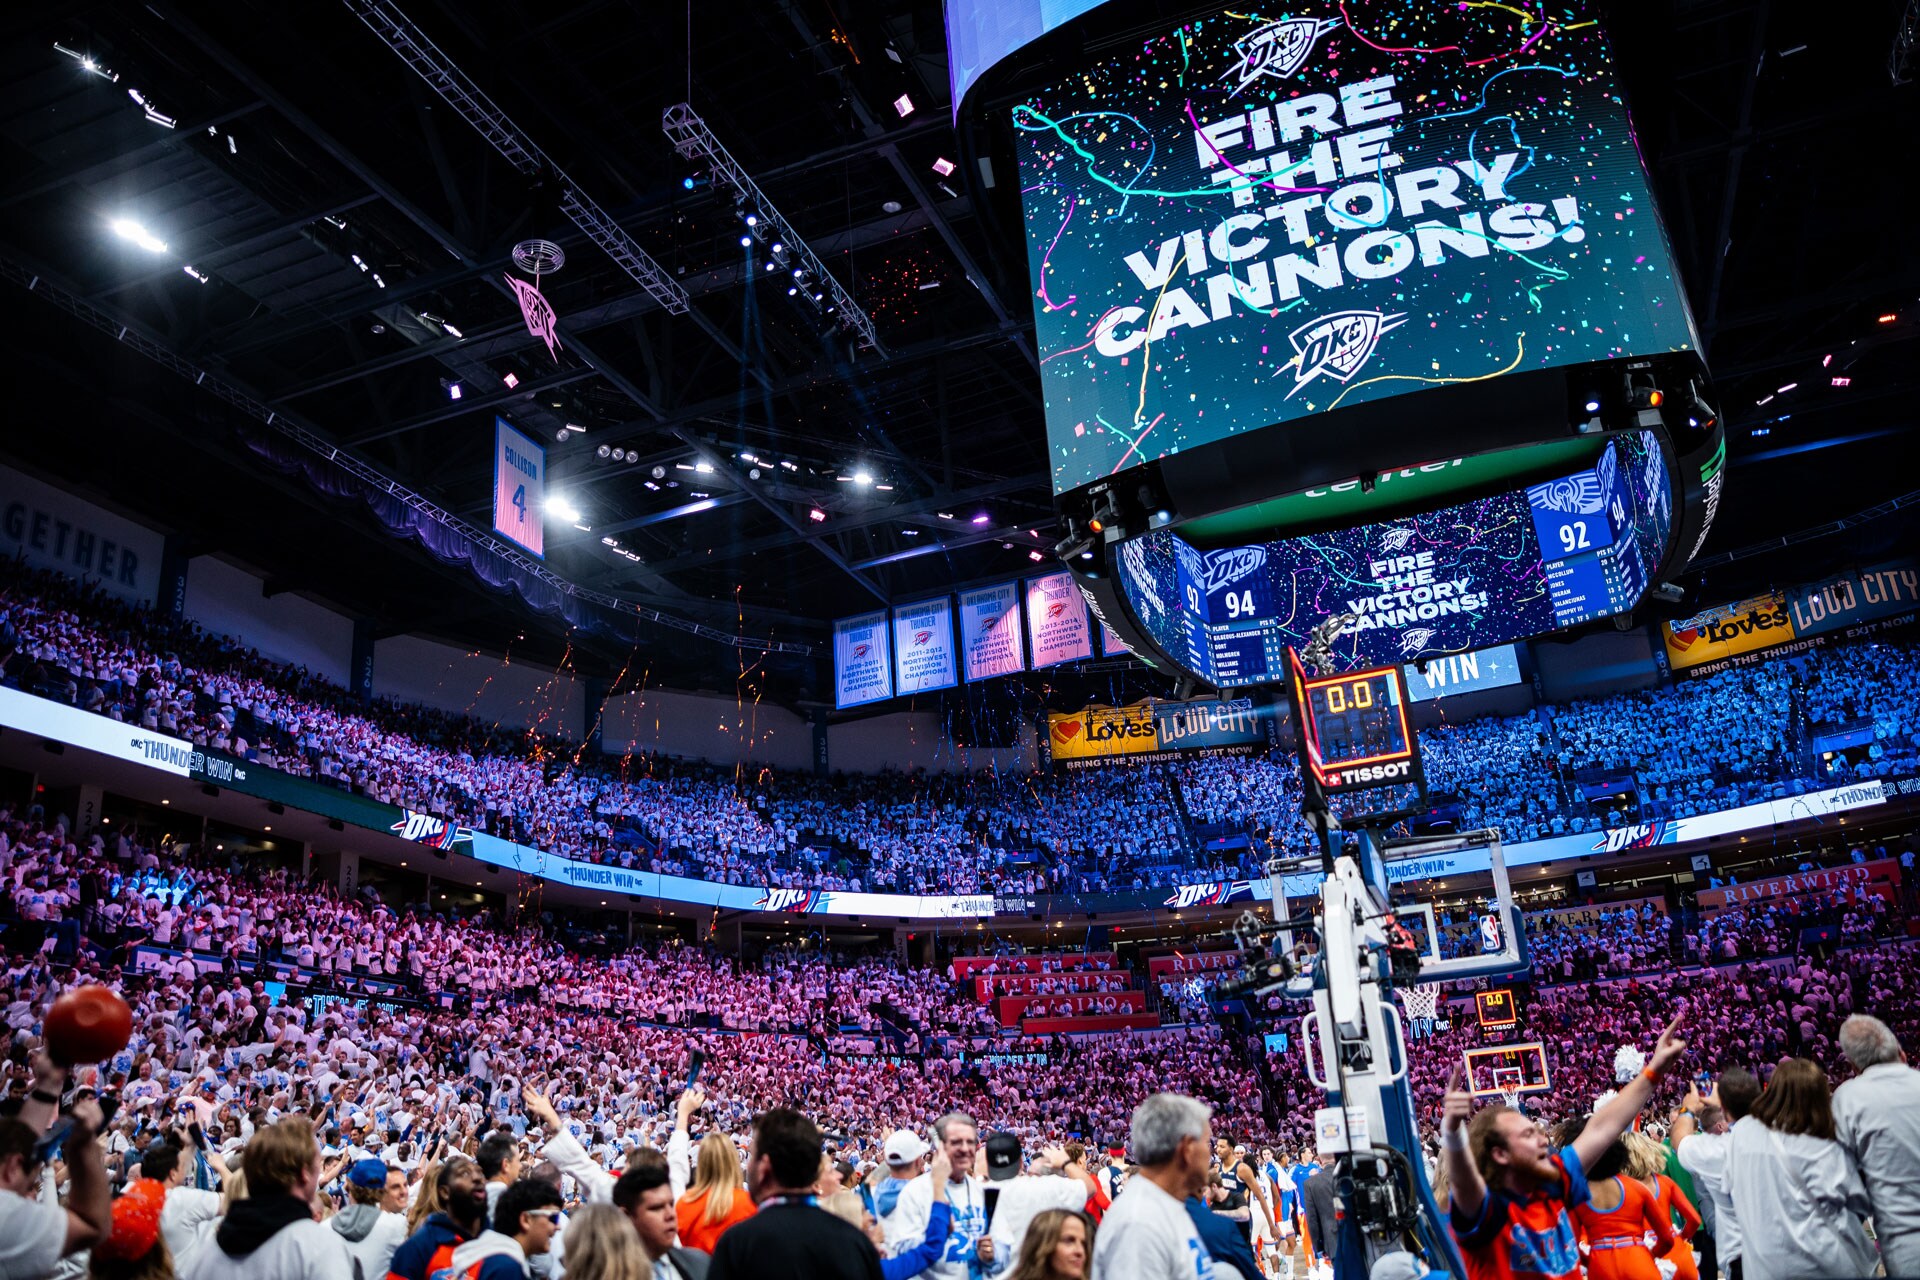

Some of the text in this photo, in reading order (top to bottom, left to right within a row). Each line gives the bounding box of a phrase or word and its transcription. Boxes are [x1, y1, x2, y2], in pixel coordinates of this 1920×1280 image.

[1195, 75, 1404, 169] FIRE
[1211, 125, 1402, 209] THE
[1124, 153, 1520, 290] VICTORY
[1093, 197, 1585, 358] CANNONS!
[505, 445, 537, 480] COLLISON
[512, 484, 527, 523] 4
[4, 502, 138, 587] GETHER
[1560, 522, 1591, 553] 92
[1370, 551, 1435, 577] FIRE
[1546, 561, 1565, 571] PLAYER
[1596, 549, 1607, 558] PTS
[1033, 576, 1065, 592] OKLAHOMA
[1376, 568, 1435, 592] THE
[1547, 568, 1574, 580] MCCOLLUM
[1550, 580, 1565, 589] JONES
[175, 576, 185, 612] 325
[966, 588, 1010, 606] OKLAHOMA CITY
[1044, 588, 1072, 602] THUNDER
[1187, 584, 1201, 615] 92
[1347, 578, 1470, 614] VICTORY
[1552, 588, 1571, 598] INGRAM
[1793, 570, 1918, 631] LOUD CITY
[977, 601, 1003, 616] THUNDER
[1225, 590, 1256, 619] 94
[1340, 590, 1489, 634] CANNONS!
[1556, 608, 1577, 617] MURPHY
[910, 616, 936, 630] THUNDER
[1037, 624, 1082, 639] NORTHWEST
[1040, 618, 1079, 631] 2013-2014
[970, 638, 1014, 652] NORTHWEST
[1039, 639, 1083, 652] CHAMPIONS
[1043, 633, 1077, 644] DIVISION
[1690, 614, 1915, 678] BRING THE THUNDER EXIT NOW
[903, 653, 947, 666] NORTHWEST
[907, 647, 943, 658] 2011-2012
[972, 652, 1014, 665] CHAMPIONS
[977, 646, 1008, 658] DIVISION
[364, 656, 372, 688] 326
[842, 666, 883, 680] NORTHWEST
[904, 667, 948, 680] CHAMPIONS
[909, 662, 942, 672] DIVISION
[1217, 660, 1239, 668] WILLIAMS
[1218, 669, 1239, 677] WALLACE
[1425, 652, 1480, 690] WIN
[1657, 650, 1669, 678] 302
[843, 679, 883, 693] CHAMPIONS
[848, 674, 878, 685] DIVISION
[1532, 673, 1543, 699] 301
[1327, 680, 1373, 713] 0.0
[1161, 705, 1259, 744] LOUD CITY
[1268, 720, 1276, 745] 330
[131, 739, 246, 781] OKC THUNDER WIN OKC
[818, 737, 827, 764] 328
[1042, 740, 1051, 764] 329
[1066, 746, 1253, 770] BRING THE THUNDER EXIT NOW
[1341, 761, 1411, 784] TISSOT
[1840, 782, 1898, 806] THUNDER
[569, 867, 612, 885] THUNDER
[614, 873, 634, 888] WIN
[1388, 862, 1422, 878] UNDER
[1422, 860, 1444, 874] WIN
[1725, 867, 1870, 903] RIVERWIND
[960, 899, 1004, 912] THUNDER
[1005, 899, 1025, 912] WIN
[1486, 994, 1503, 1006] 0.0
[1435, 1020, 1450, 1030] OKC
